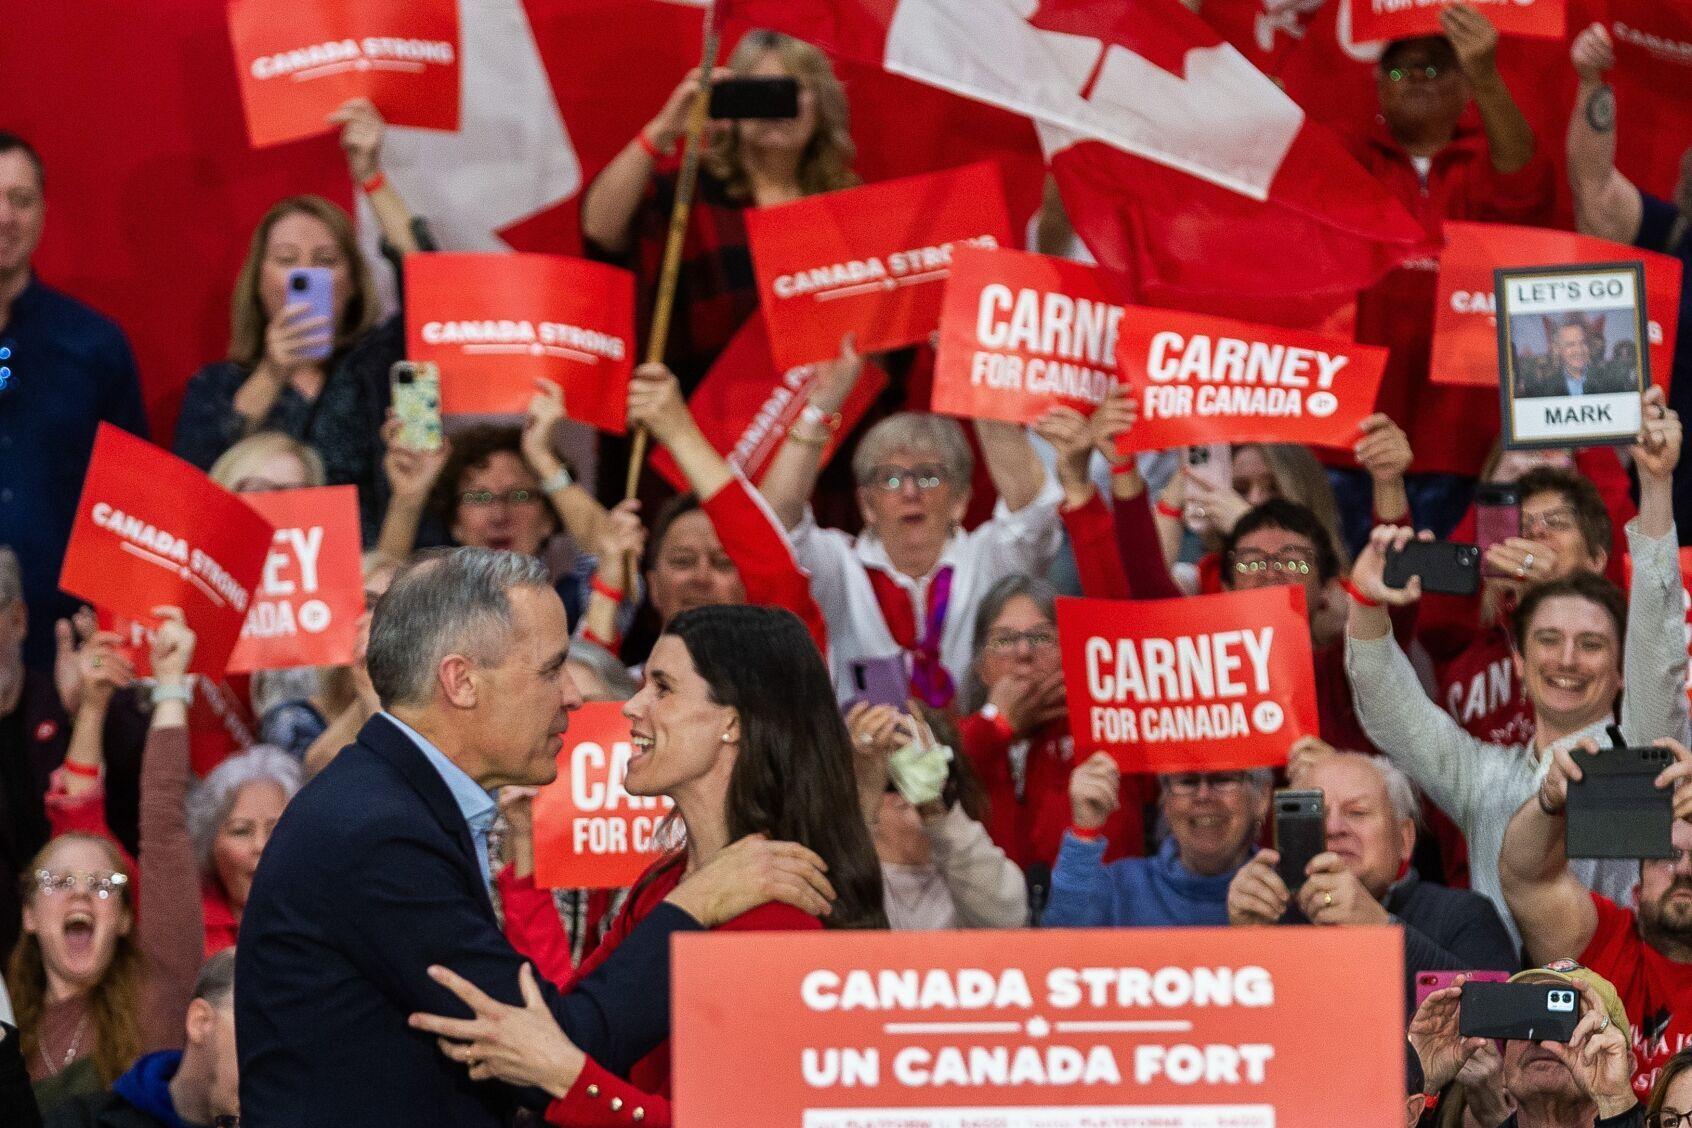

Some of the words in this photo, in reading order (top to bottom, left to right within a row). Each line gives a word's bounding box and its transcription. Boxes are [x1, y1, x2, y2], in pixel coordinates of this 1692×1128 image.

[251, 39, 361, 79] CANADA
[773, 257, 887, 298] CANADA
[888, 235, 998, 275] STROG
[1518, 281, 1581, 302] LET'S
[1589, 279, 1623, 298] GO
[423, 320, 536, 344] CANADA
[538, 322, 624, 361] STRONG
[1147, 331, 1348, 389] CARNEY
[971, 351, 1023, 390] FOR
[1144, 385, 1193, 419] FOR
[1196, 385, 1302, 417] CANADA
[1545, 404, 1612, 424] MARK
[728, 386, 793, 462] ANADA
[93, 503, 188, 562] CANADA
[1085, 626, 1274, 703] CARNEY
[1090, 706, 1138, 743] FOR
[1141, 702, 1250, 742] CANADA
[571, 742, 675, 811] CA
[573, 817, 627, 854] FOR
[802, 969, 1032, 1010] CANADA
[1047, 966, 1274, 1007] STRONG
[802, 1048, 879, 1087] UN
[894, 1046, 1120, 1086] CANADA
[1135, 1044, 1274, 1084] FORT
